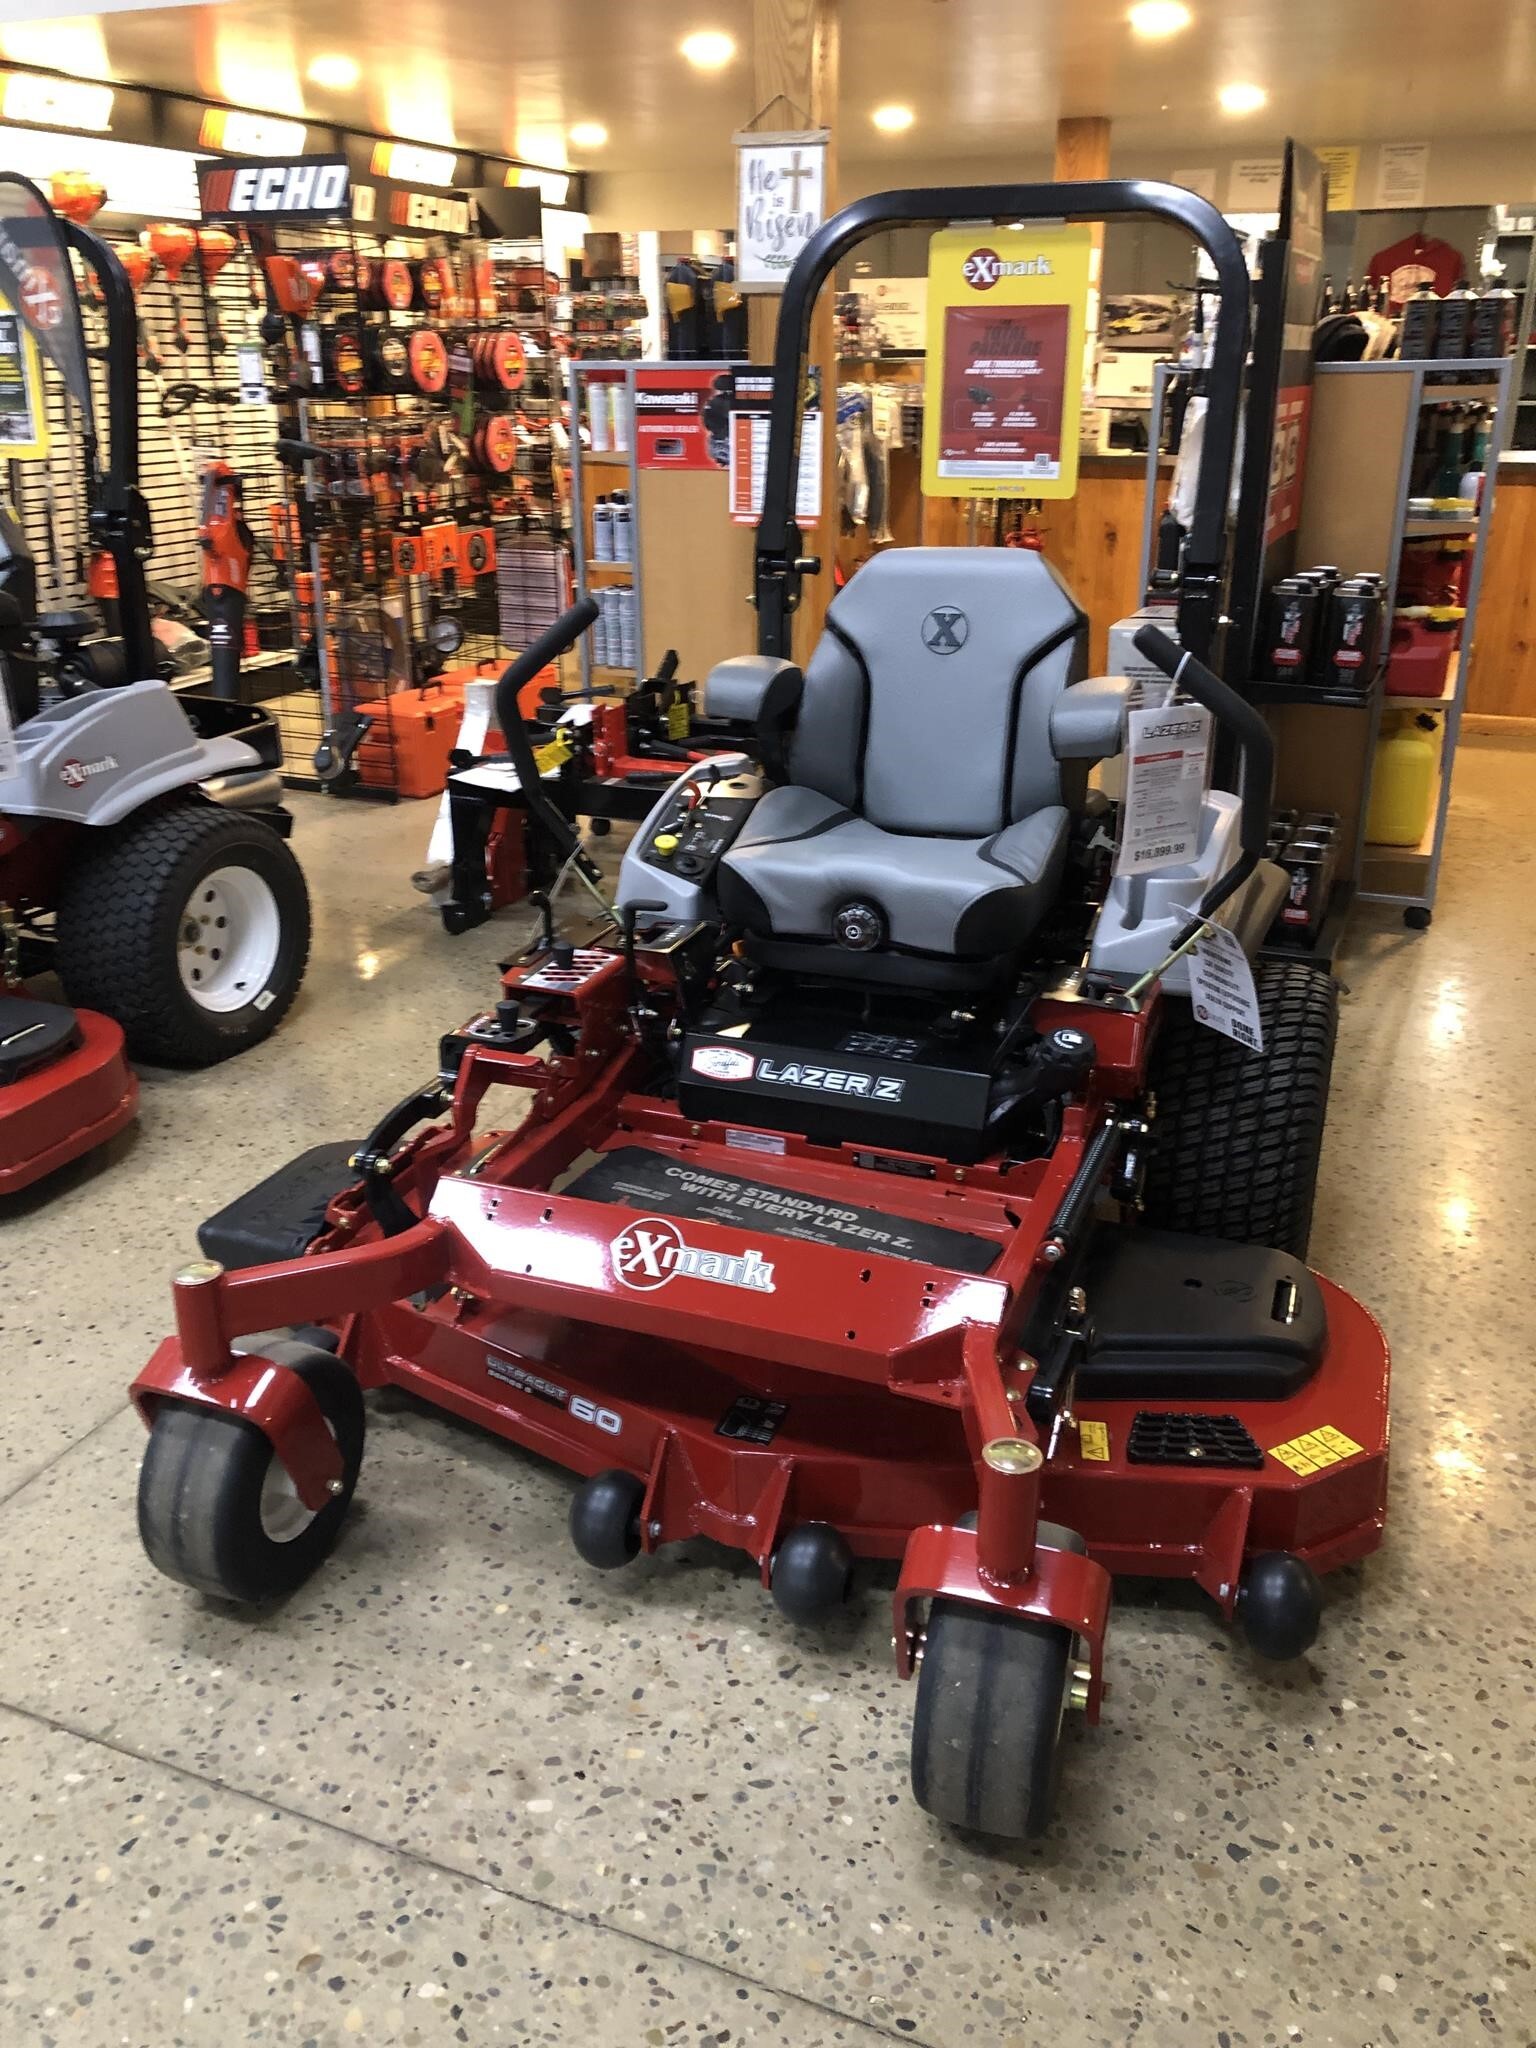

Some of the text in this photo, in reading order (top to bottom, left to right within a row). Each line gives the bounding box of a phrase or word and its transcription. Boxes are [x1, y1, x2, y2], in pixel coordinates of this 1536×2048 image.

[227, 164, 348, 212] ECHO
[748, 158, 778, 195] He
[771, 193, 785, 208] is
[745, 196, 814, 252] Risen
[961, 253, 1053, 284] eXmark
[634, 391, 699, 405] Kawasaki
[926, 611, 963, 647] X
[1142, 719, 1202, 739] LAZER Z
[58, 753, 119, 785] eXmark
[756, 1059, 871, 1098] LAZER
[870, 1075, 907, 1102] Z
[665, 1166, 859, 1223] COMES STANDARD
[679, 1182, 914, 1250] WITH EVERY LAZER Z.
[611, 1225, 776, 1292] eXmark
[569, 1394, 623, 1436] 60
